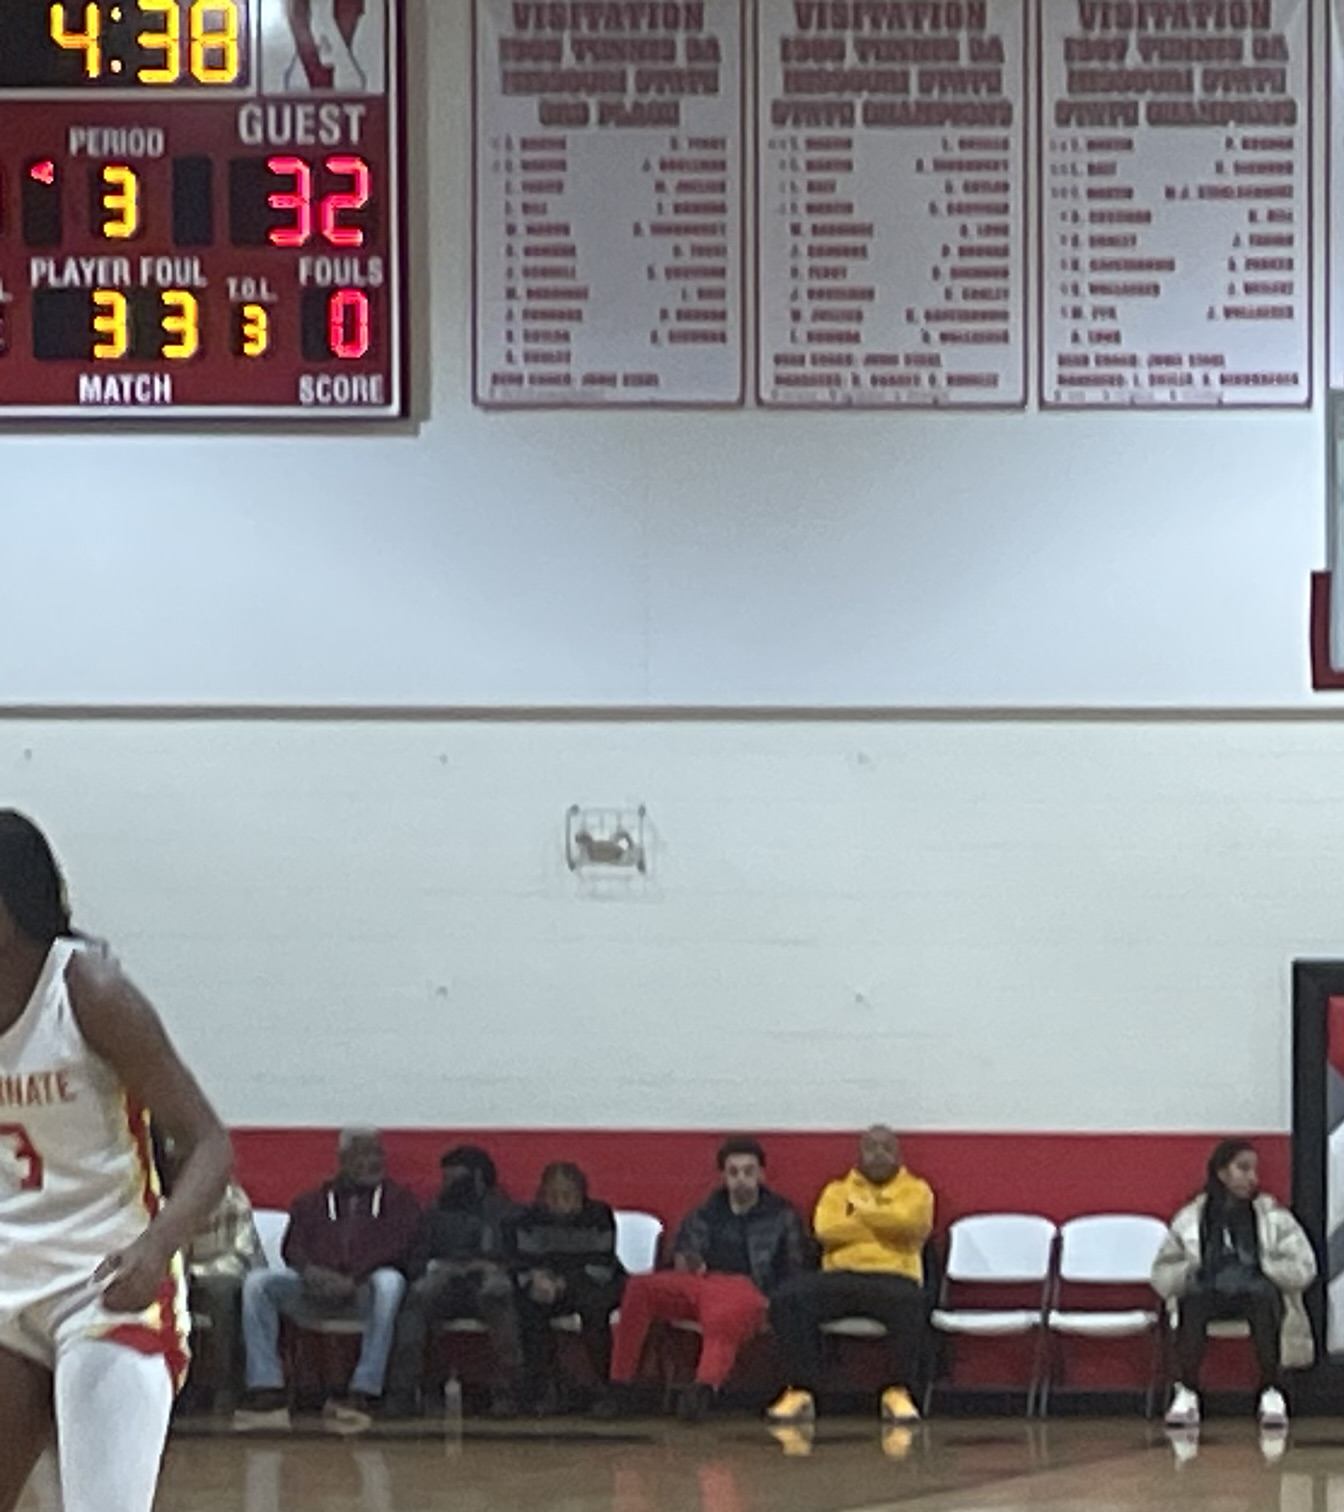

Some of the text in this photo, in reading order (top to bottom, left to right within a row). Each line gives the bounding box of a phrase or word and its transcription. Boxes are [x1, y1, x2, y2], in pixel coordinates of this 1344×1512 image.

[513, 2, 704, 31] VISITATION
[50, 0, 239, 84] 4:38
[69, 127, 164, 158] PERIOD
[238, 103, 367, 146] GUEST
[103, 165, 138, 238] 3
[266, 156, 371, 247] 32
[30, 257, 207, 287] PLAYER FOUL
[300, 256, 384, 286] FOULS
[93, 290, 128, 359] 3
[162, 290, 199, 359] 3
[242, 303, 268, 357] 3
[327, 289, 370, 359] 0
[78, 373, 173, 404] MATCH
[299, 373, 385, 405] SCORE
